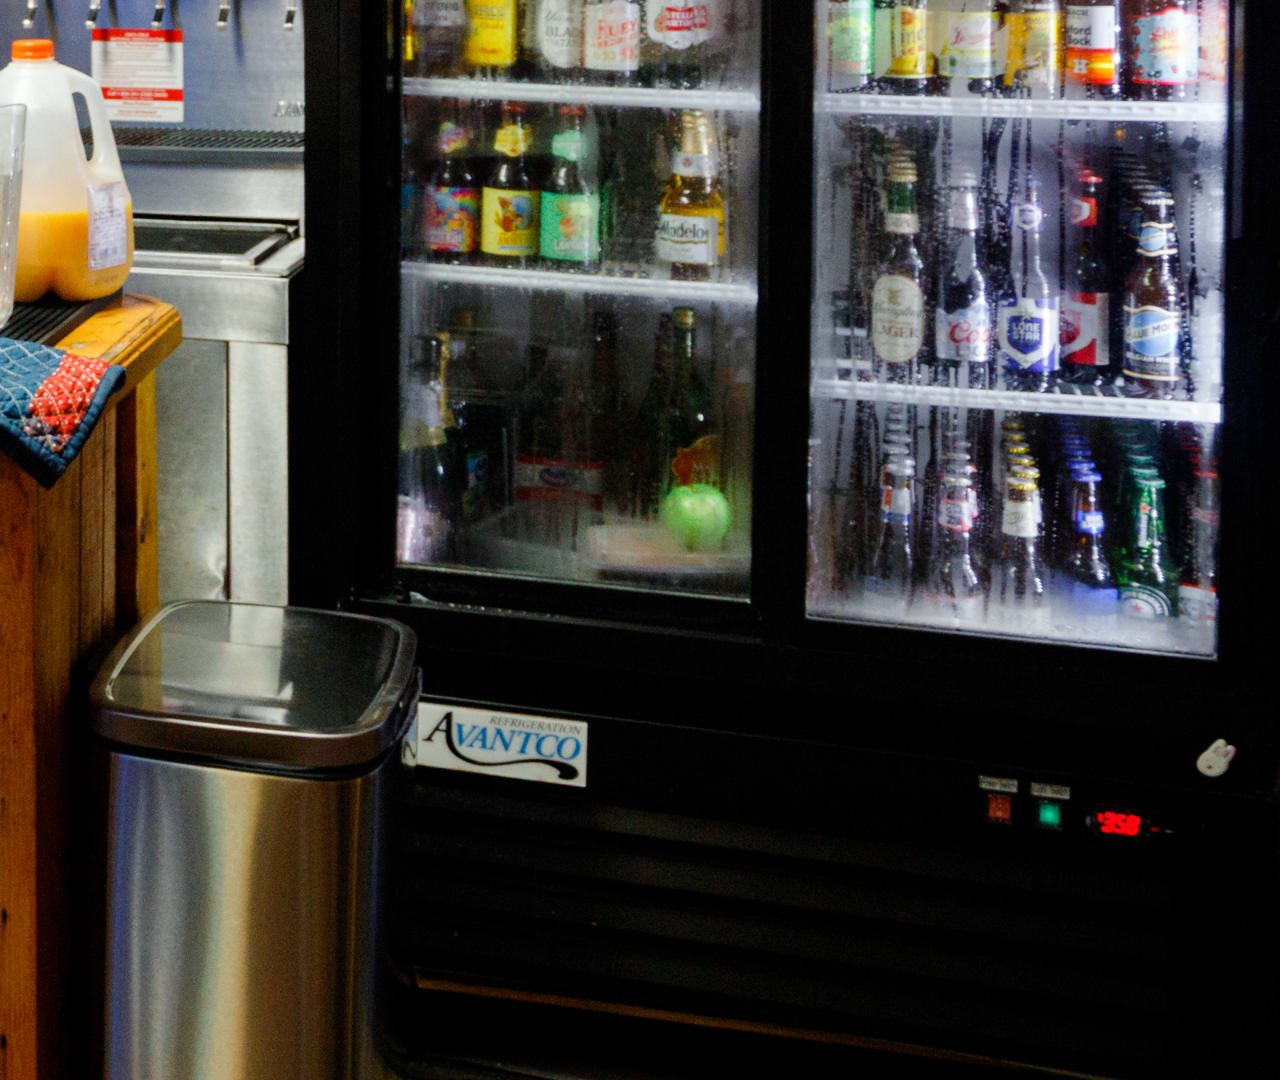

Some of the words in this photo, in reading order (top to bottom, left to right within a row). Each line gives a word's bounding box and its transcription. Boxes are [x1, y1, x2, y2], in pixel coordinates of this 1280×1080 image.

[1012, 322, 1040, 332] LONE
[1012, 331, 1040, 342] STAR
[489, 715, 583, 735] REFRIGERATION
[421, 710, 581, 761] AVANTCO
